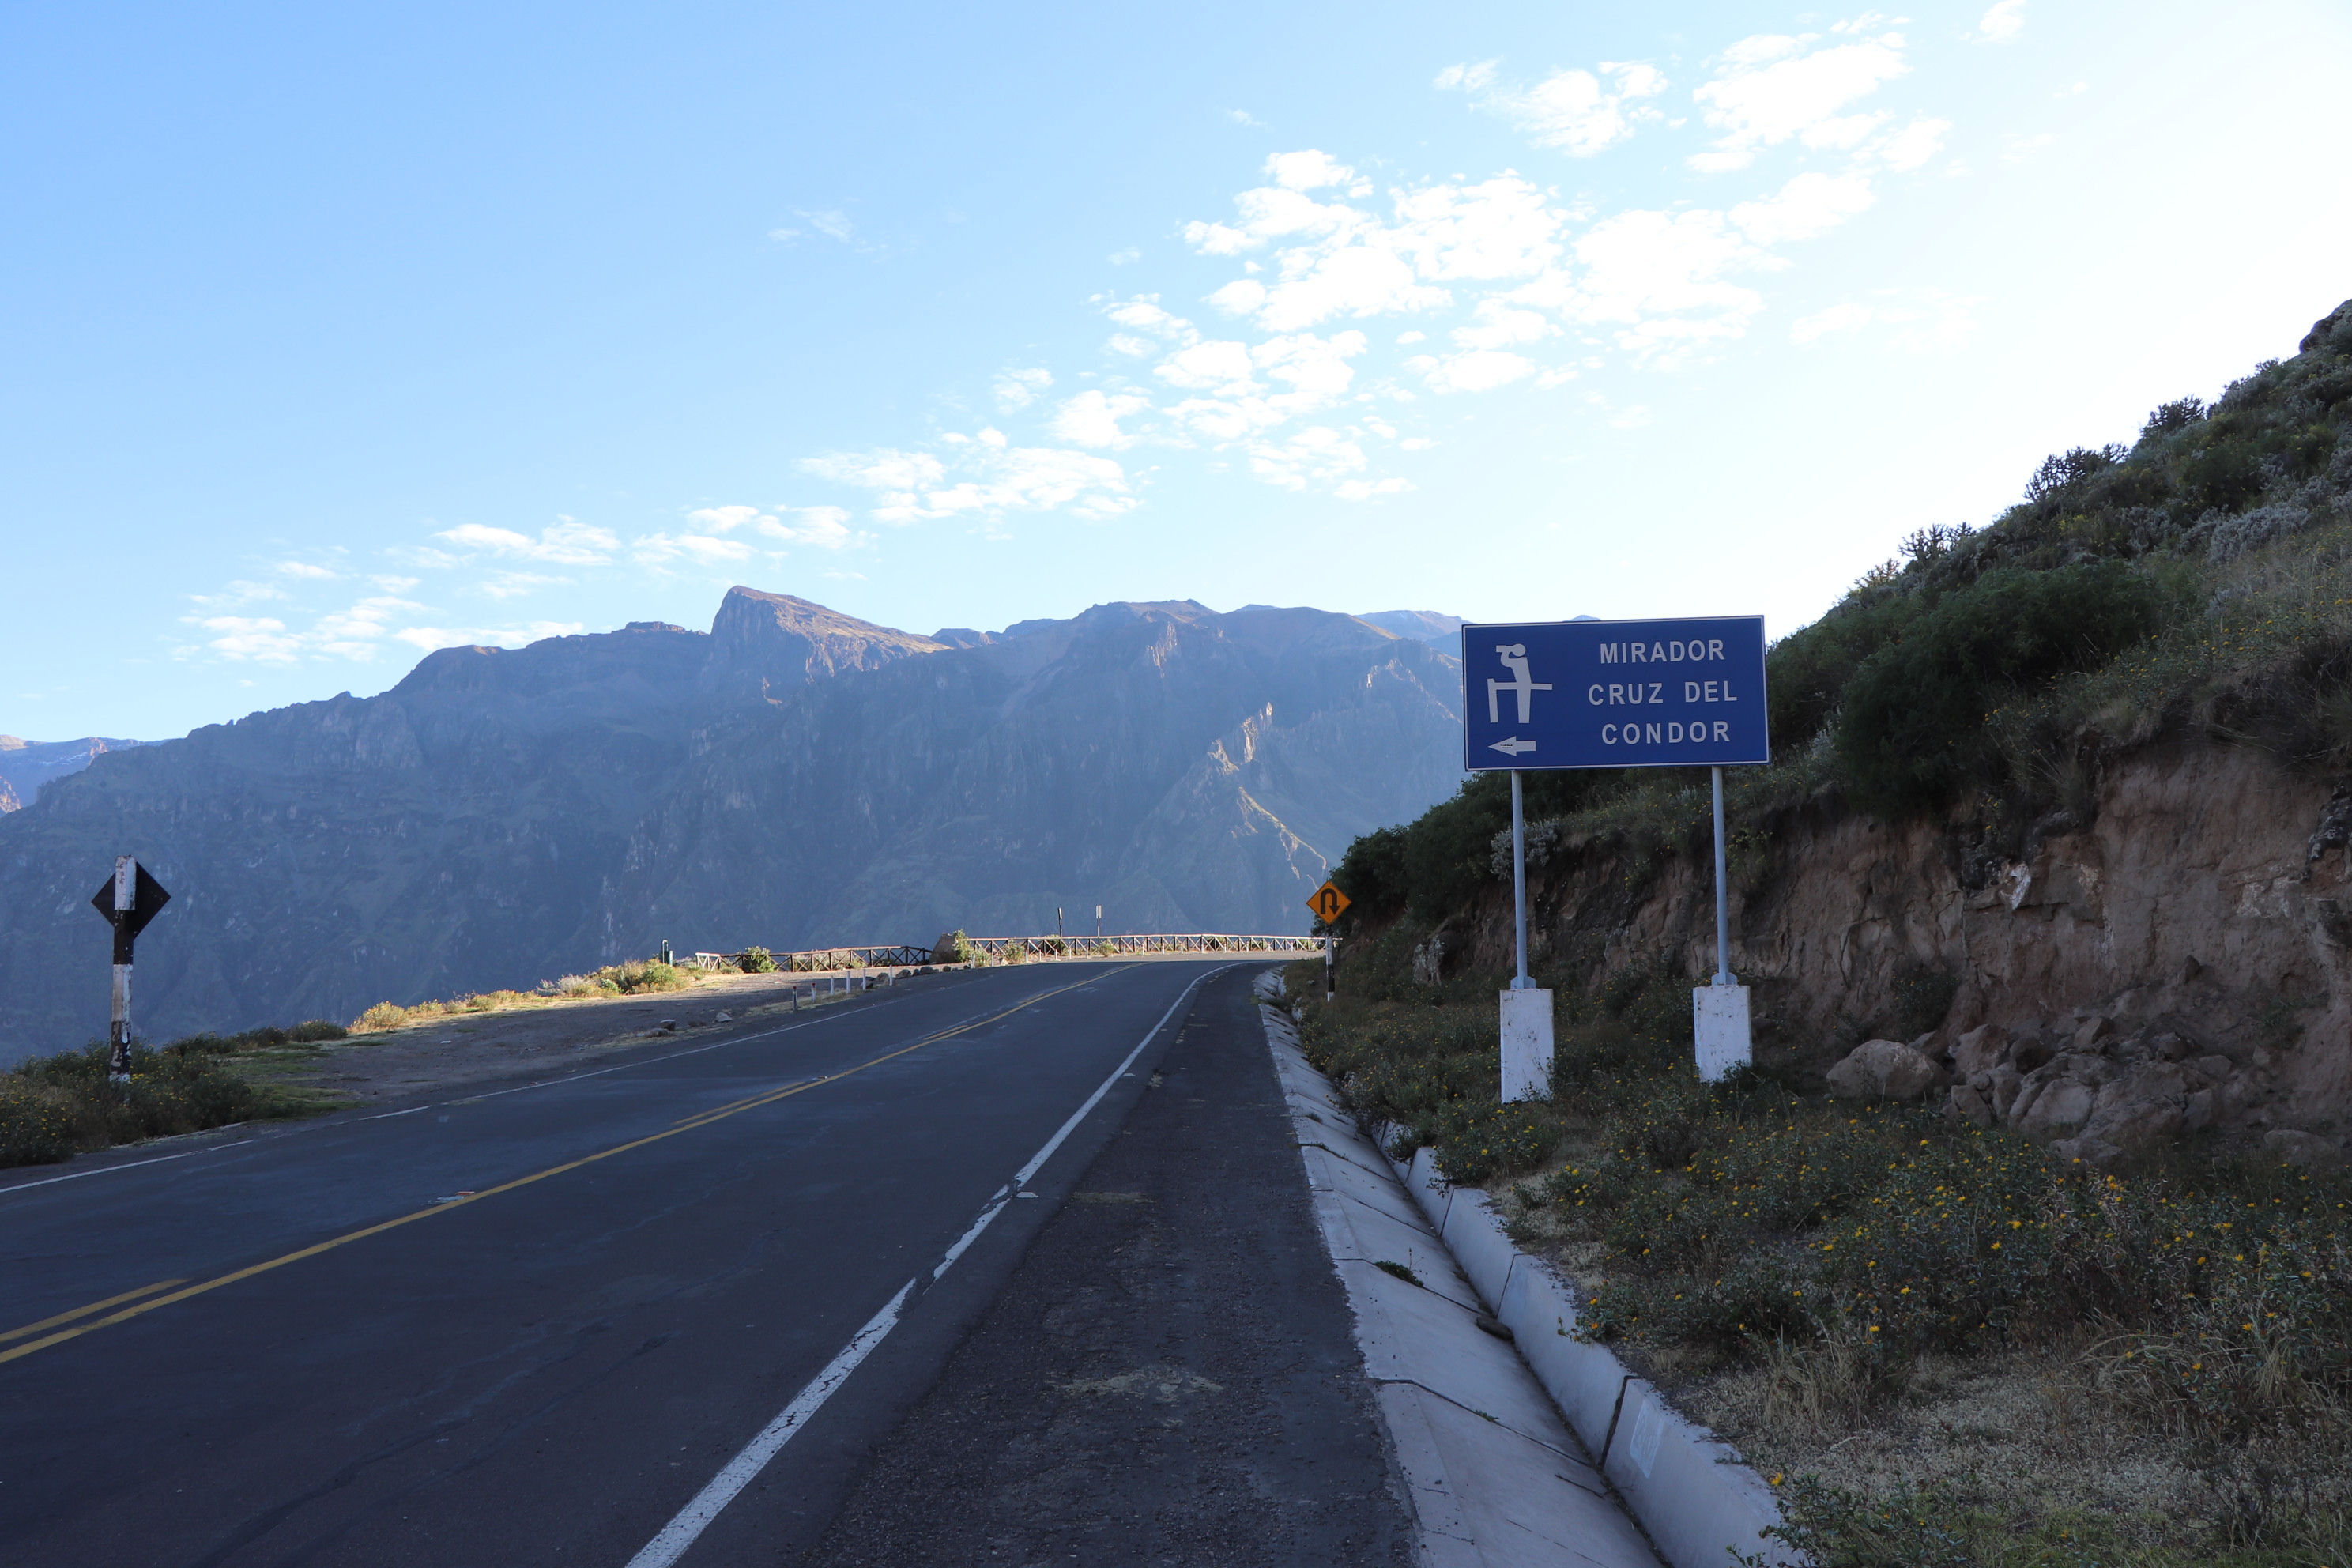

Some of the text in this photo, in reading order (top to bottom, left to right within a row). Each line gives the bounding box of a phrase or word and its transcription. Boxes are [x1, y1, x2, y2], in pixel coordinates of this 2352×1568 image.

[1600, 639, 1724, 663] MIRADOR
[1589, 681, 1737, 705] CRUZ DEL
[1601, 721, 1730, 744] CONDOR
